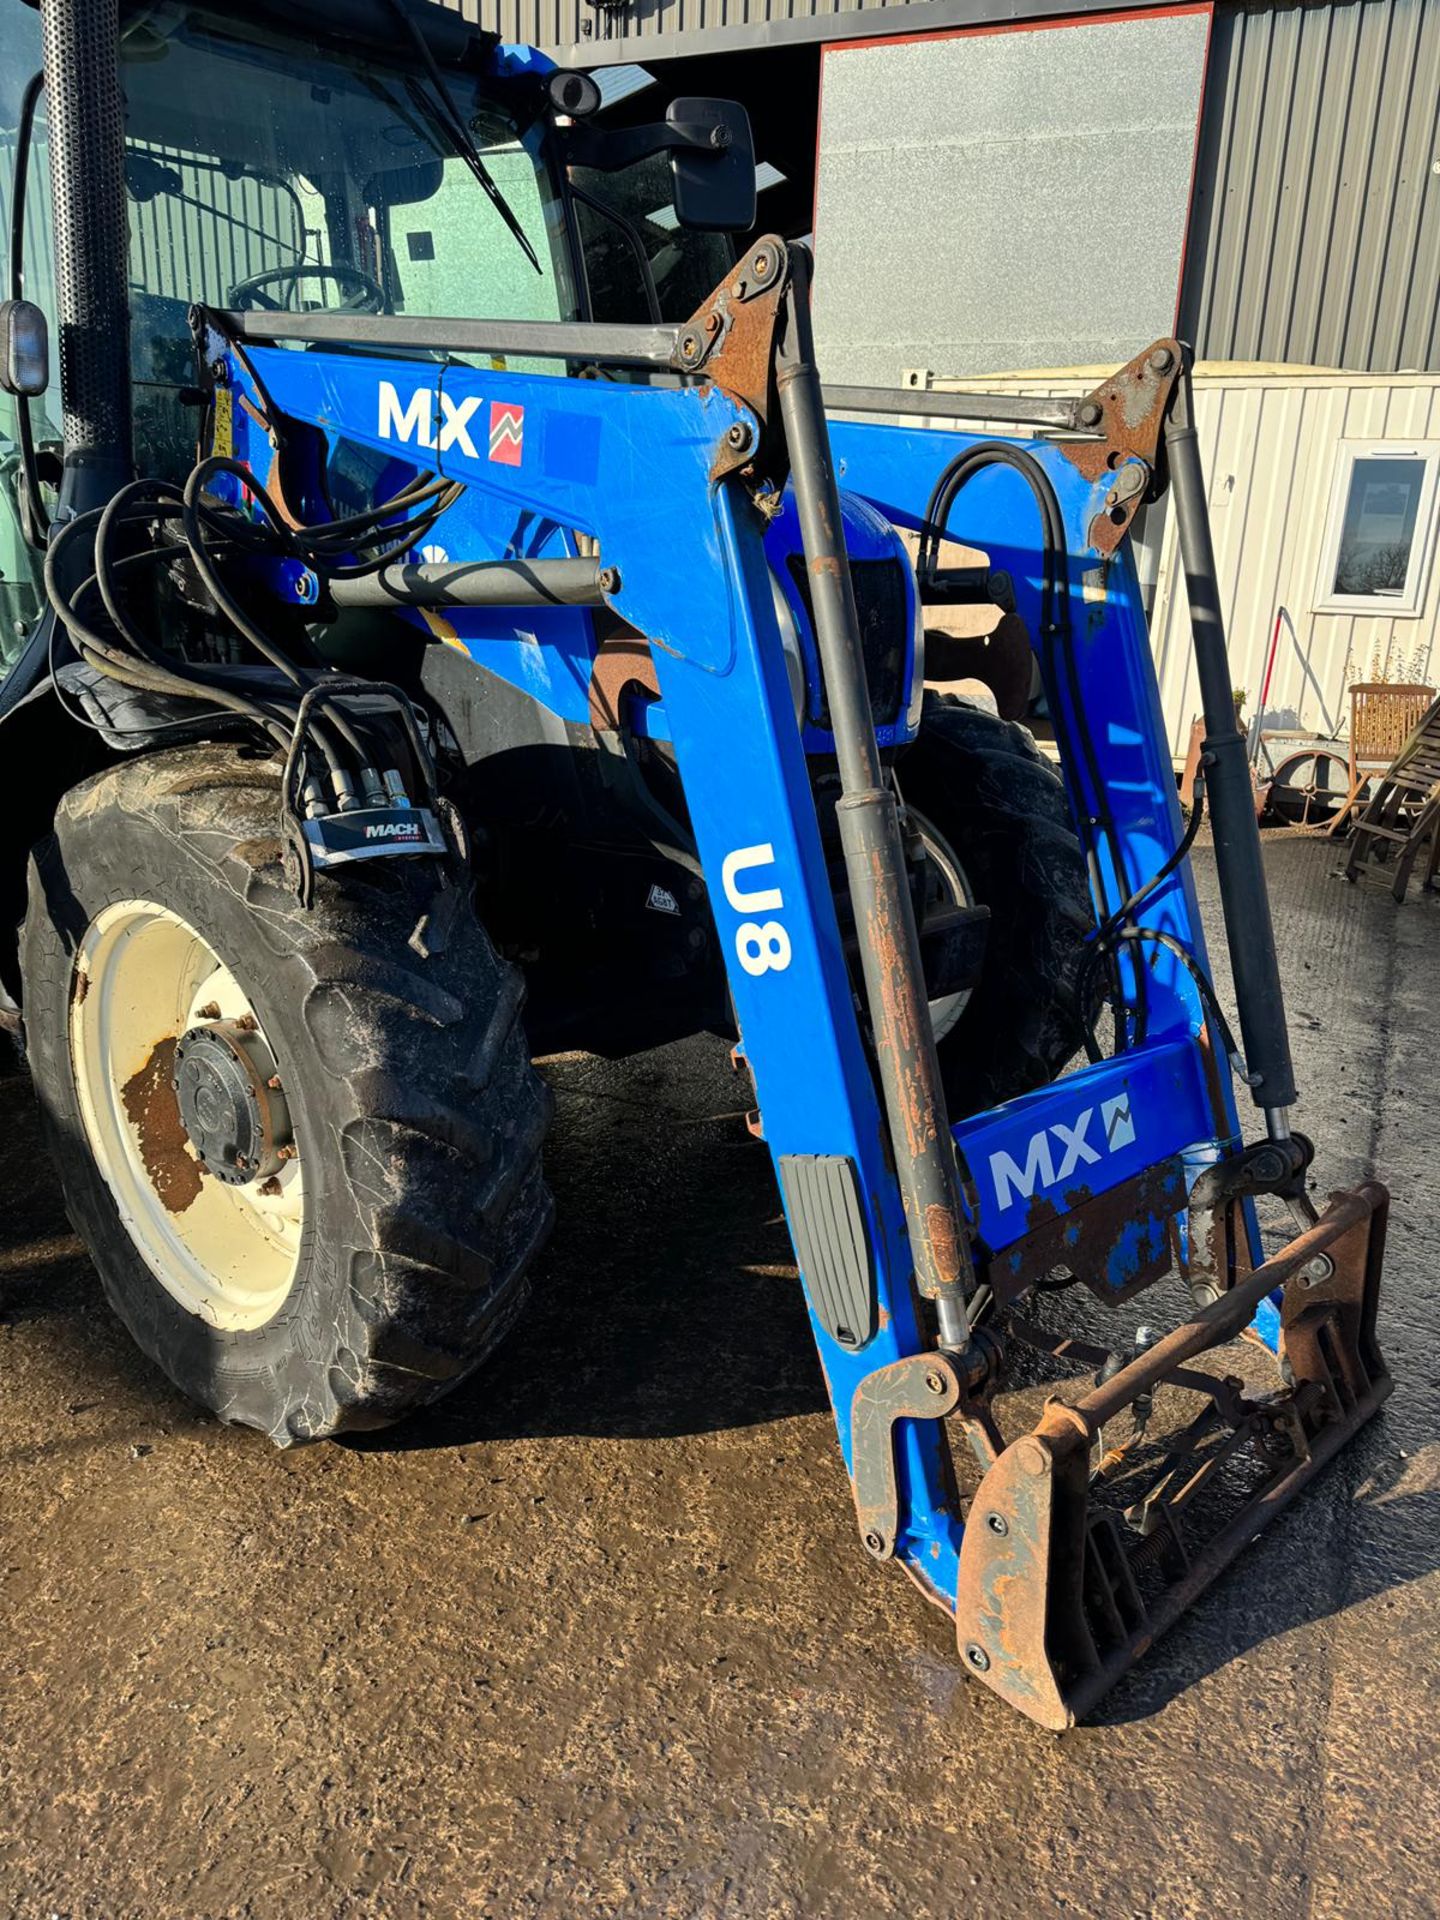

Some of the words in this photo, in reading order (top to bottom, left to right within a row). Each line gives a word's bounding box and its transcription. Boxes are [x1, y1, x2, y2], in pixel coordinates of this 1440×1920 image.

[378, 380, 484, 459] MX
[366, 823, 418, 838] MACH
[722, 842, 792, 976] U8
[988, 1107, 1102, 1212] MX
